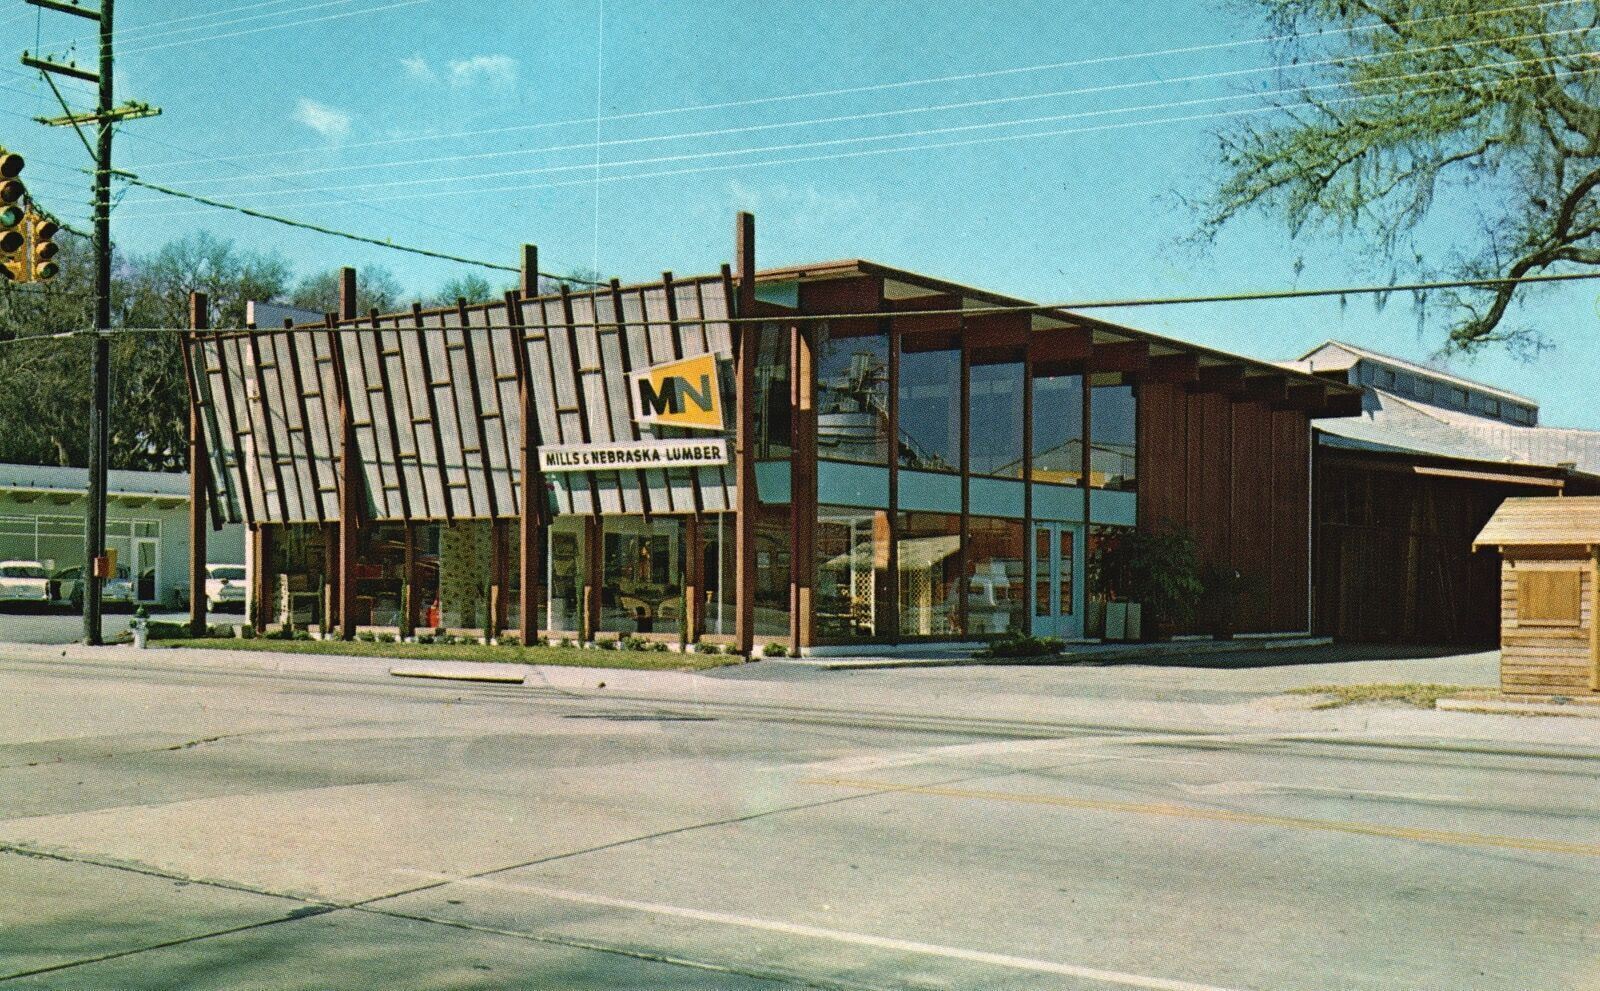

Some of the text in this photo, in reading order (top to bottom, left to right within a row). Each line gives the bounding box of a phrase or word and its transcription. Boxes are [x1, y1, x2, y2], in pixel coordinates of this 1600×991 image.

[638, 374, 713, 416] MN
[546, 451, 580, 466] MILLS
[591, 448, 661, 463] NEBRASKA
[665, 446, 722, 461] LUMBER
